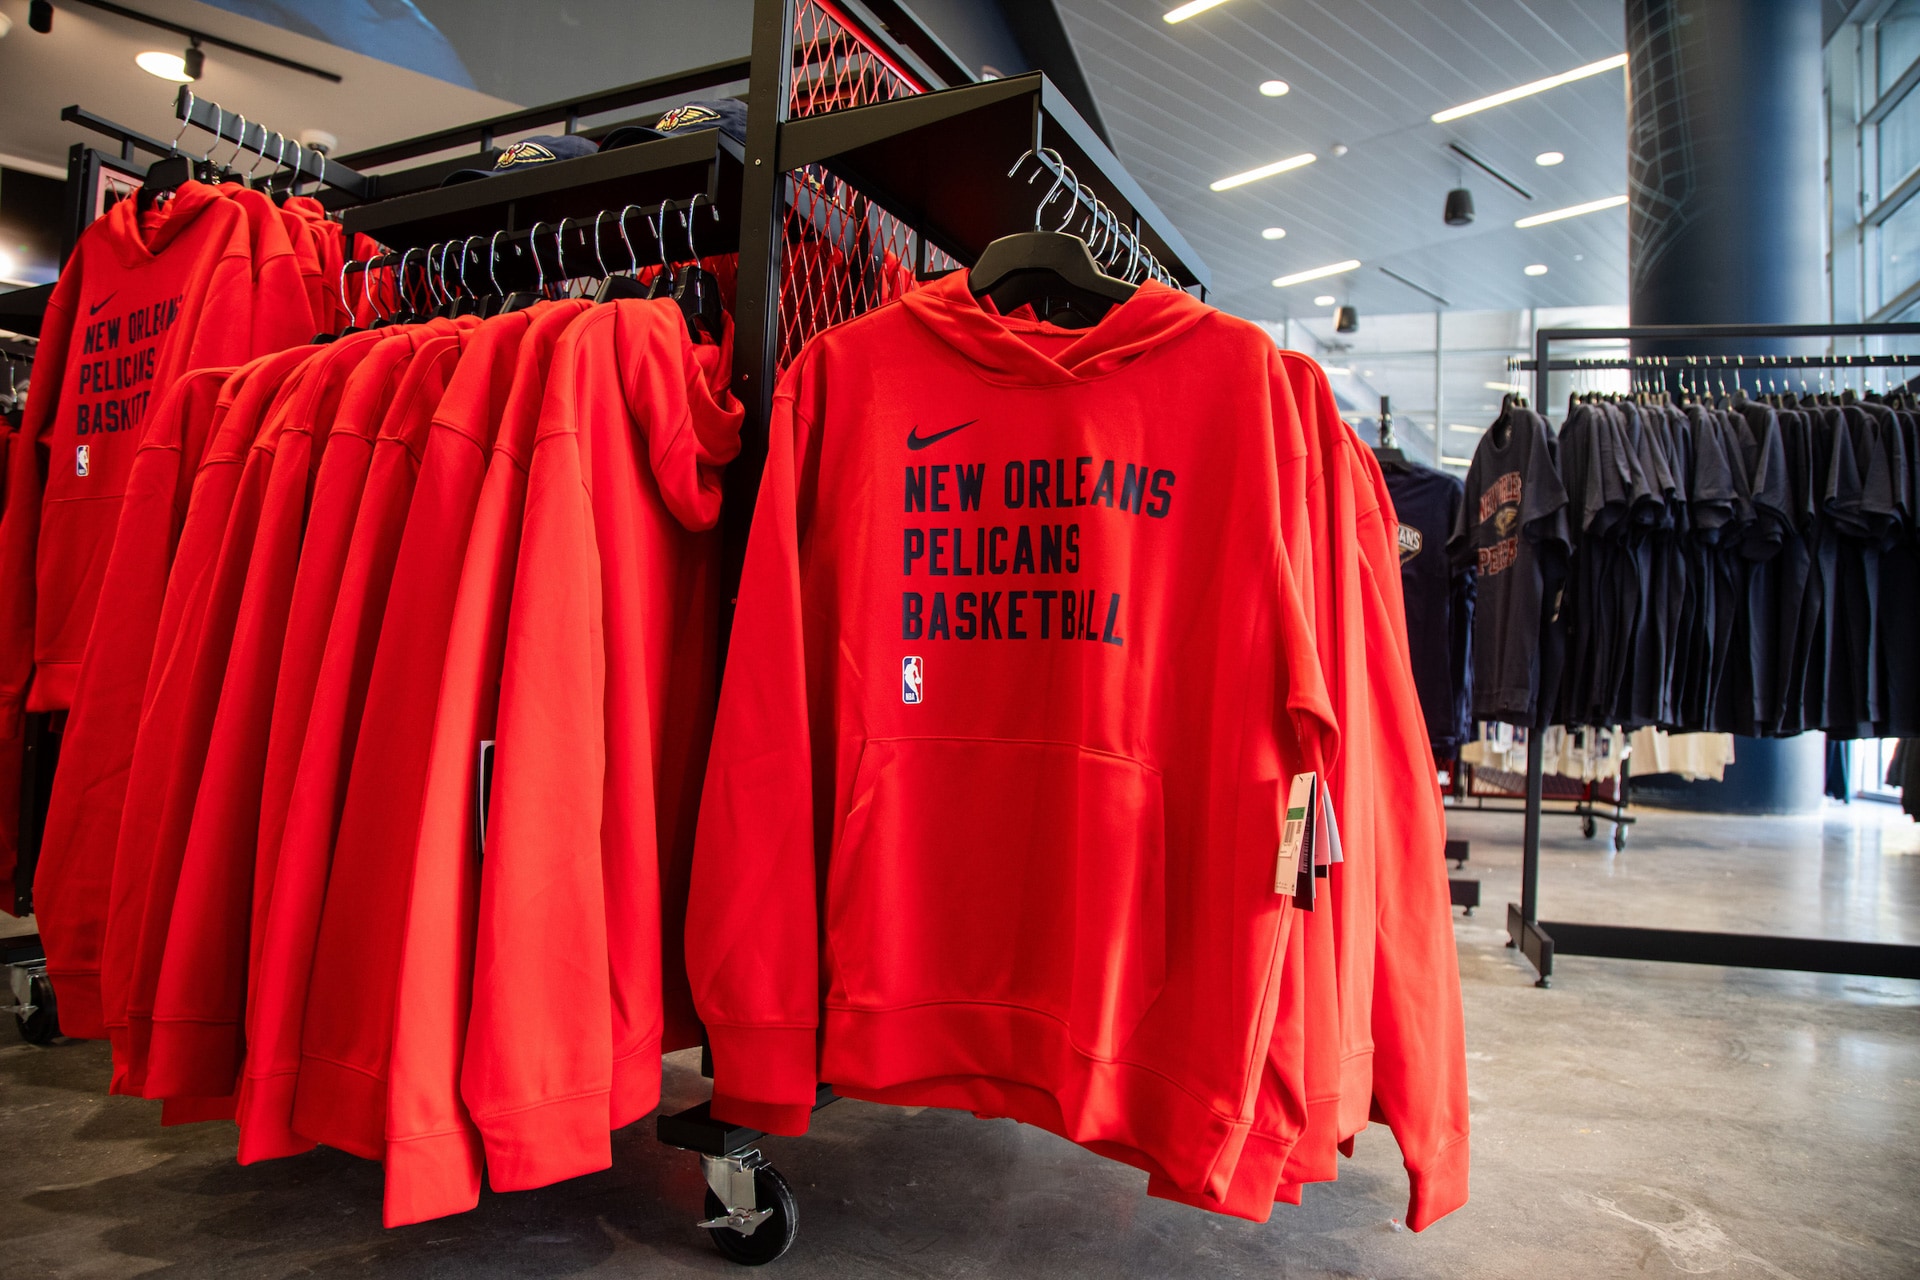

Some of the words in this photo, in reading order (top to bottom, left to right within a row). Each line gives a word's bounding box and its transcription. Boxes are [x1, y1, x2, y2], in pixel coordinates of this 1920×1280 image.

[83, 317, 121, 355] NEW
[128, 294, 183, 344] ORLEAN
[79, 347, 156, 395] PELICANS
[904, 463, 986, 513] NEW
[1004, 457, 1176, 519] ORLEANS
[903, 524, 1080, 576] PELICANS
[902, 590, 1124, 647] BASKETBALL
